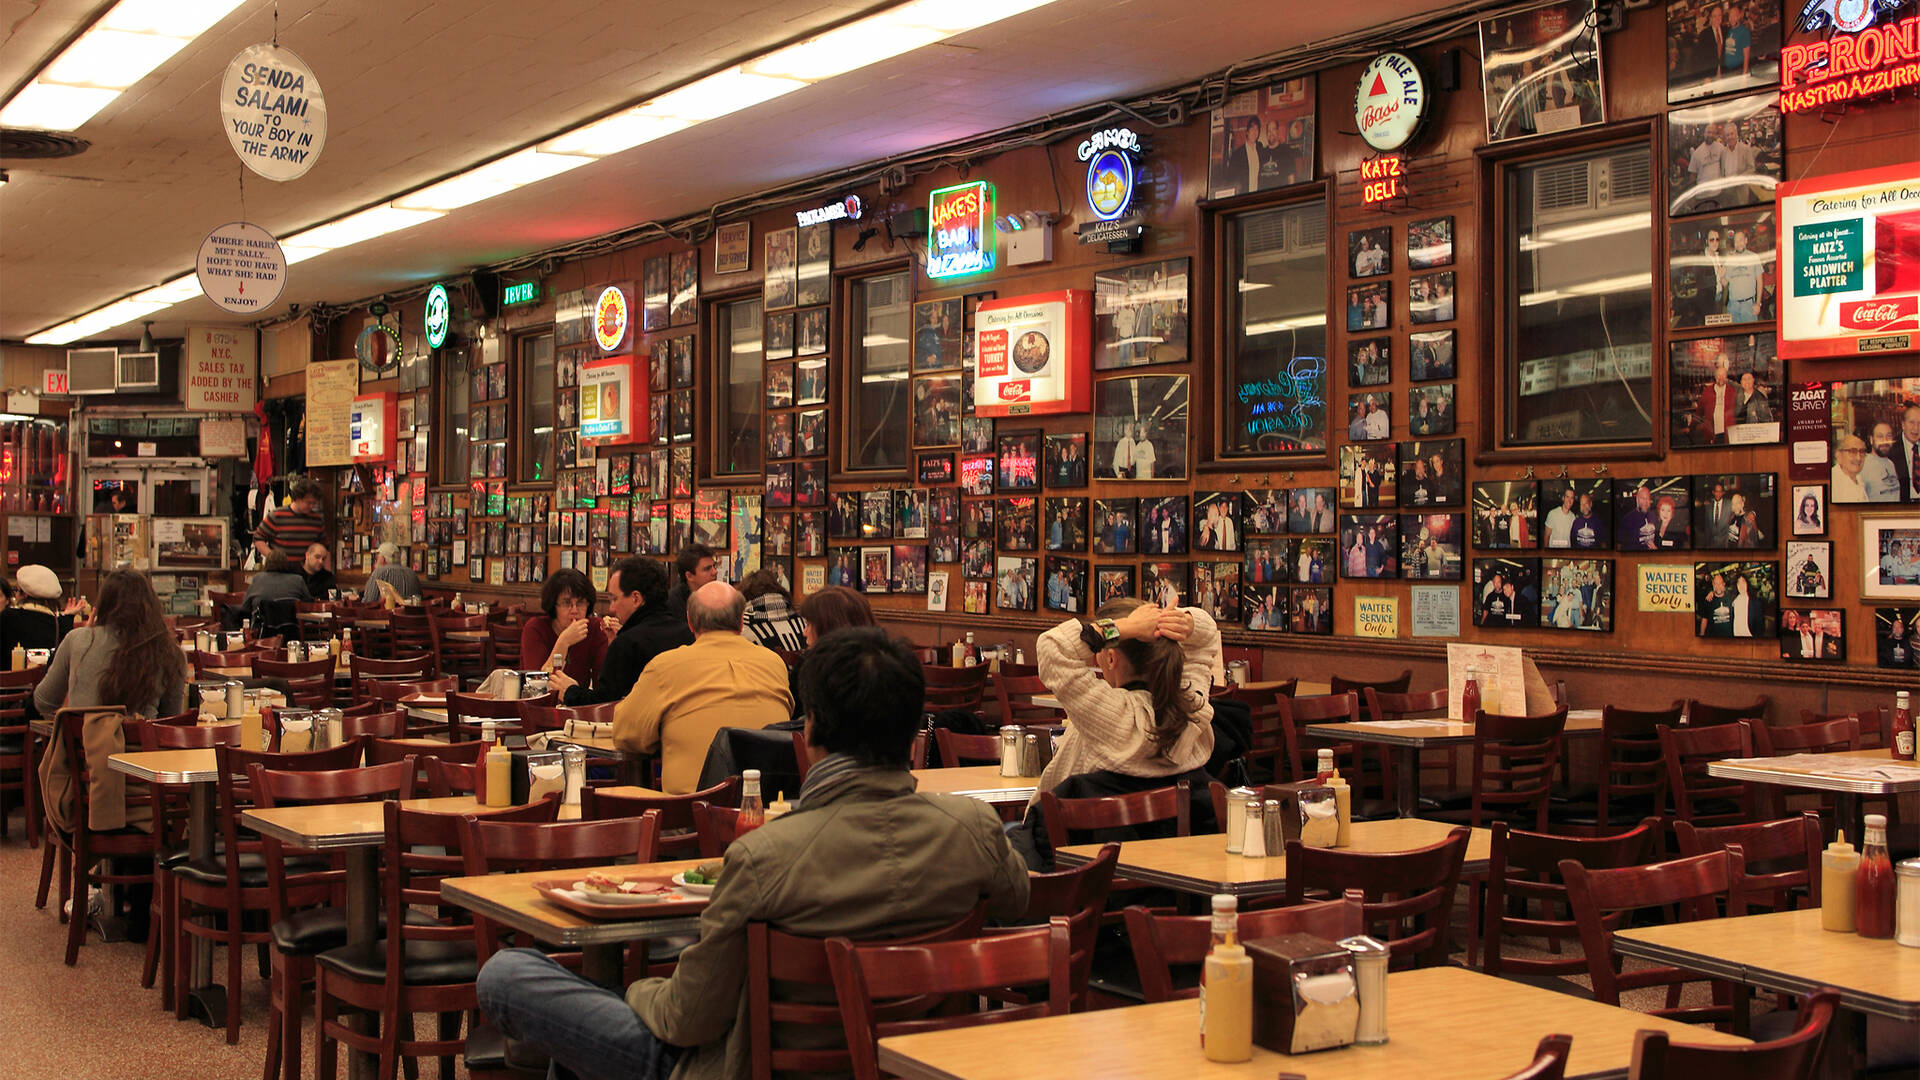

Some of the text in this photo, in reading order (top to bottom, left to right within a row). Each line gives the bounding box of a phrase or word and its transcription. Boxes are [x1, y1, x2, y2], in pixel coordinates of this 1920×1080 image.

[1385, 55, 1413, 79] PALE
[1403, 79, 1418, 106] ALE
[235, 86, 308, 117] SALAMI
[263, 114, 282, 126] TO
[1361, 98, 1400, 132] Bass
[233, 118, 312, 147] YOUR BOY IN
[1077, 128, 1141, 161] CAMEL
[242, 140, 308, 164] THE ARMY
[1361, 157, 1401, 179] KATZ
[1364, 179, 1397, 203] DELI
[1813, 199, 1857, 213] Catering
[1861, 194, 1876, 209] for
[1880, 190, 1897, 203] All
[1095, 220, 1120, 232] KATZ'S
[210, 236, 276, 249] WHERE HARRY
[937, 227, 969, 249] BAR
[1087, 230, 1129, 243] DELICATESSEN
[215, 247, 235, 256] MET
[1812, 240, 1844, 255] KATZ'S
[206, 257, 278, 271] HOPE YOU HAVE
[1803, 261, 1854, 277] SANDWICH
[207, 267, 277, 281] WHAT SHE HAD!
[1810, 275, 1847, 289] PLATTER
[504, 282, 534, 305] JEVER
[224, 297, 258, 306] ENJOY!
[1853, 303, 1900, 323] Coca-Cola
[199, 361, 245, 374] SALES TAX
[48, 373, 67, 393] EXI
[191, 376, 252, 389] ADDED BY THE
[203, 391, 239, 403] CASHIER
[1792, 390, 1827, 401] ZAGAT
[1792, 400, 1827, 411] SURVEY
[1645, 571, 1688, 583] WAITER
[1645, 583, 1688, 595] SERVICE
[1359, 603, 1392, 613] WAITER
[1651, 594, 1682, 609] Only
[1359, 613, 1393, 623] SERVICE
[1364, 622, 1388, 635] Only
